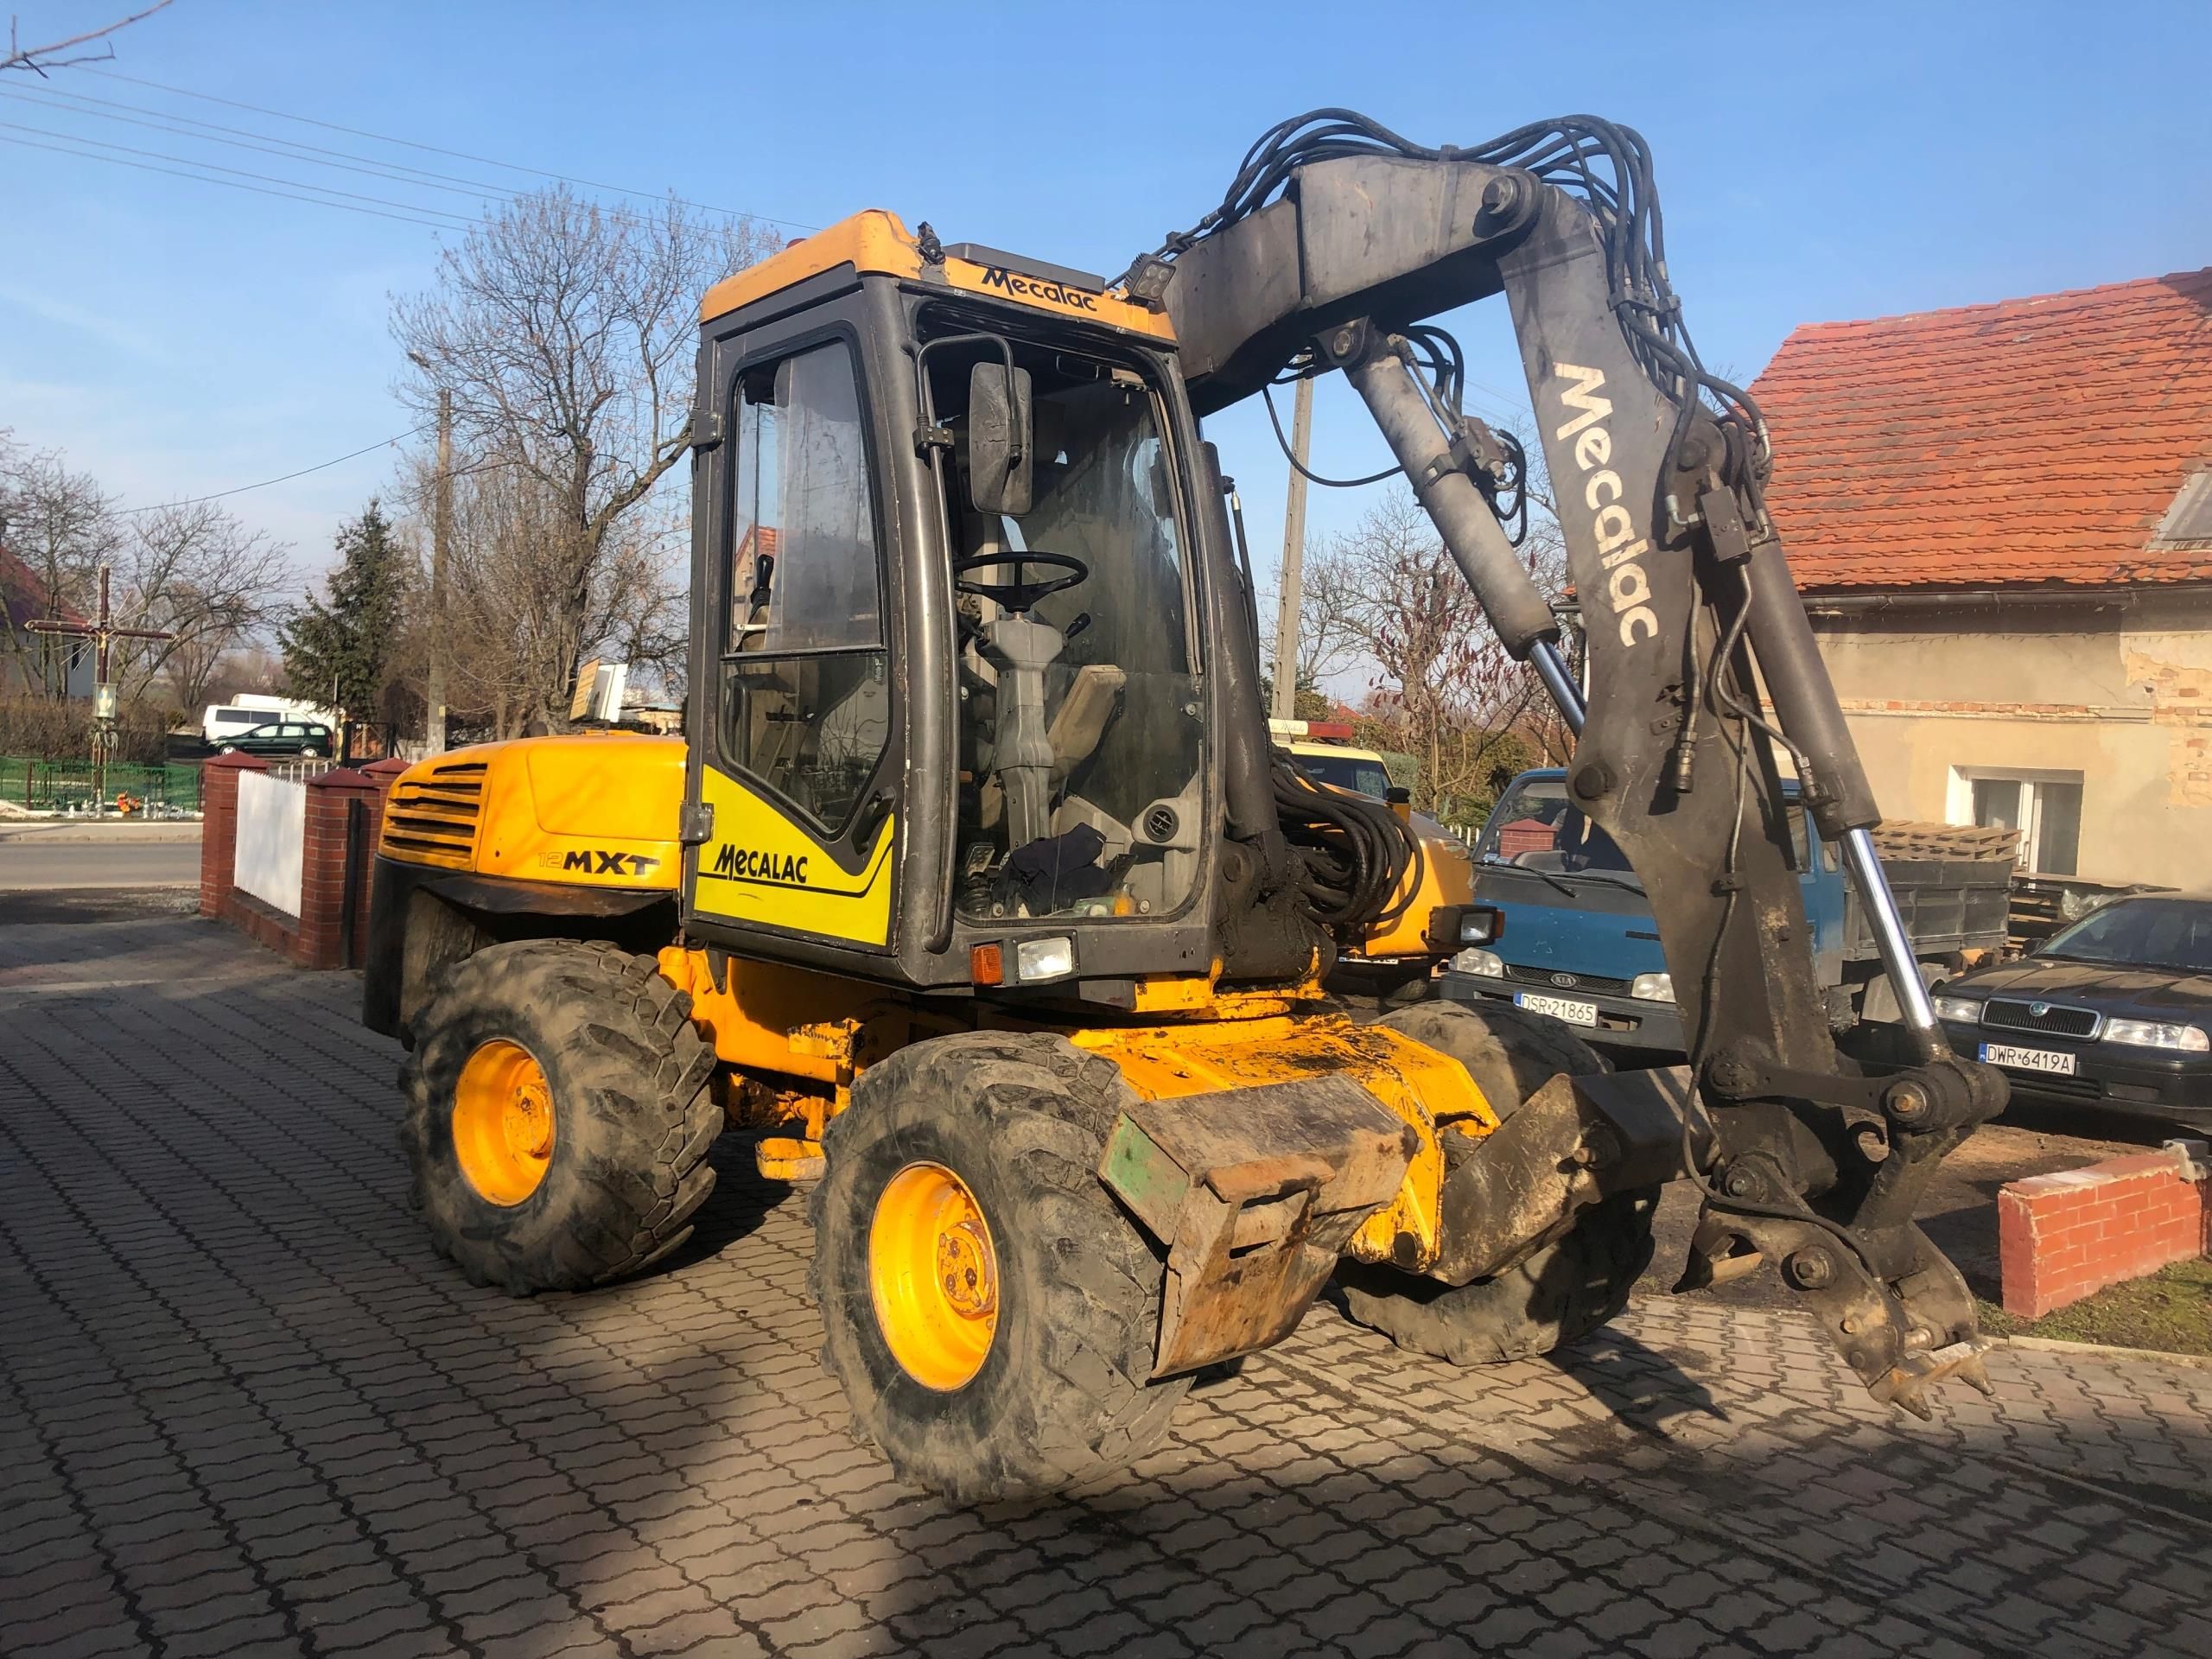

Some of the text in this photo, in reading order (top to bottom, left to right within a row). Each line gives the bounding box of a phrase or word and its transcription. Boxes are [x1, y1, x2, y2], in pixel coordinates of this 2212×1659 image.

[981, 267, 1098, 312] Mecalac
[1554, 361, 1660, 648] Mecalac
[1522, 995, 1594, 1021] DSR 21865
[1987, 1046, 2070, 1072] DWR 6419A
